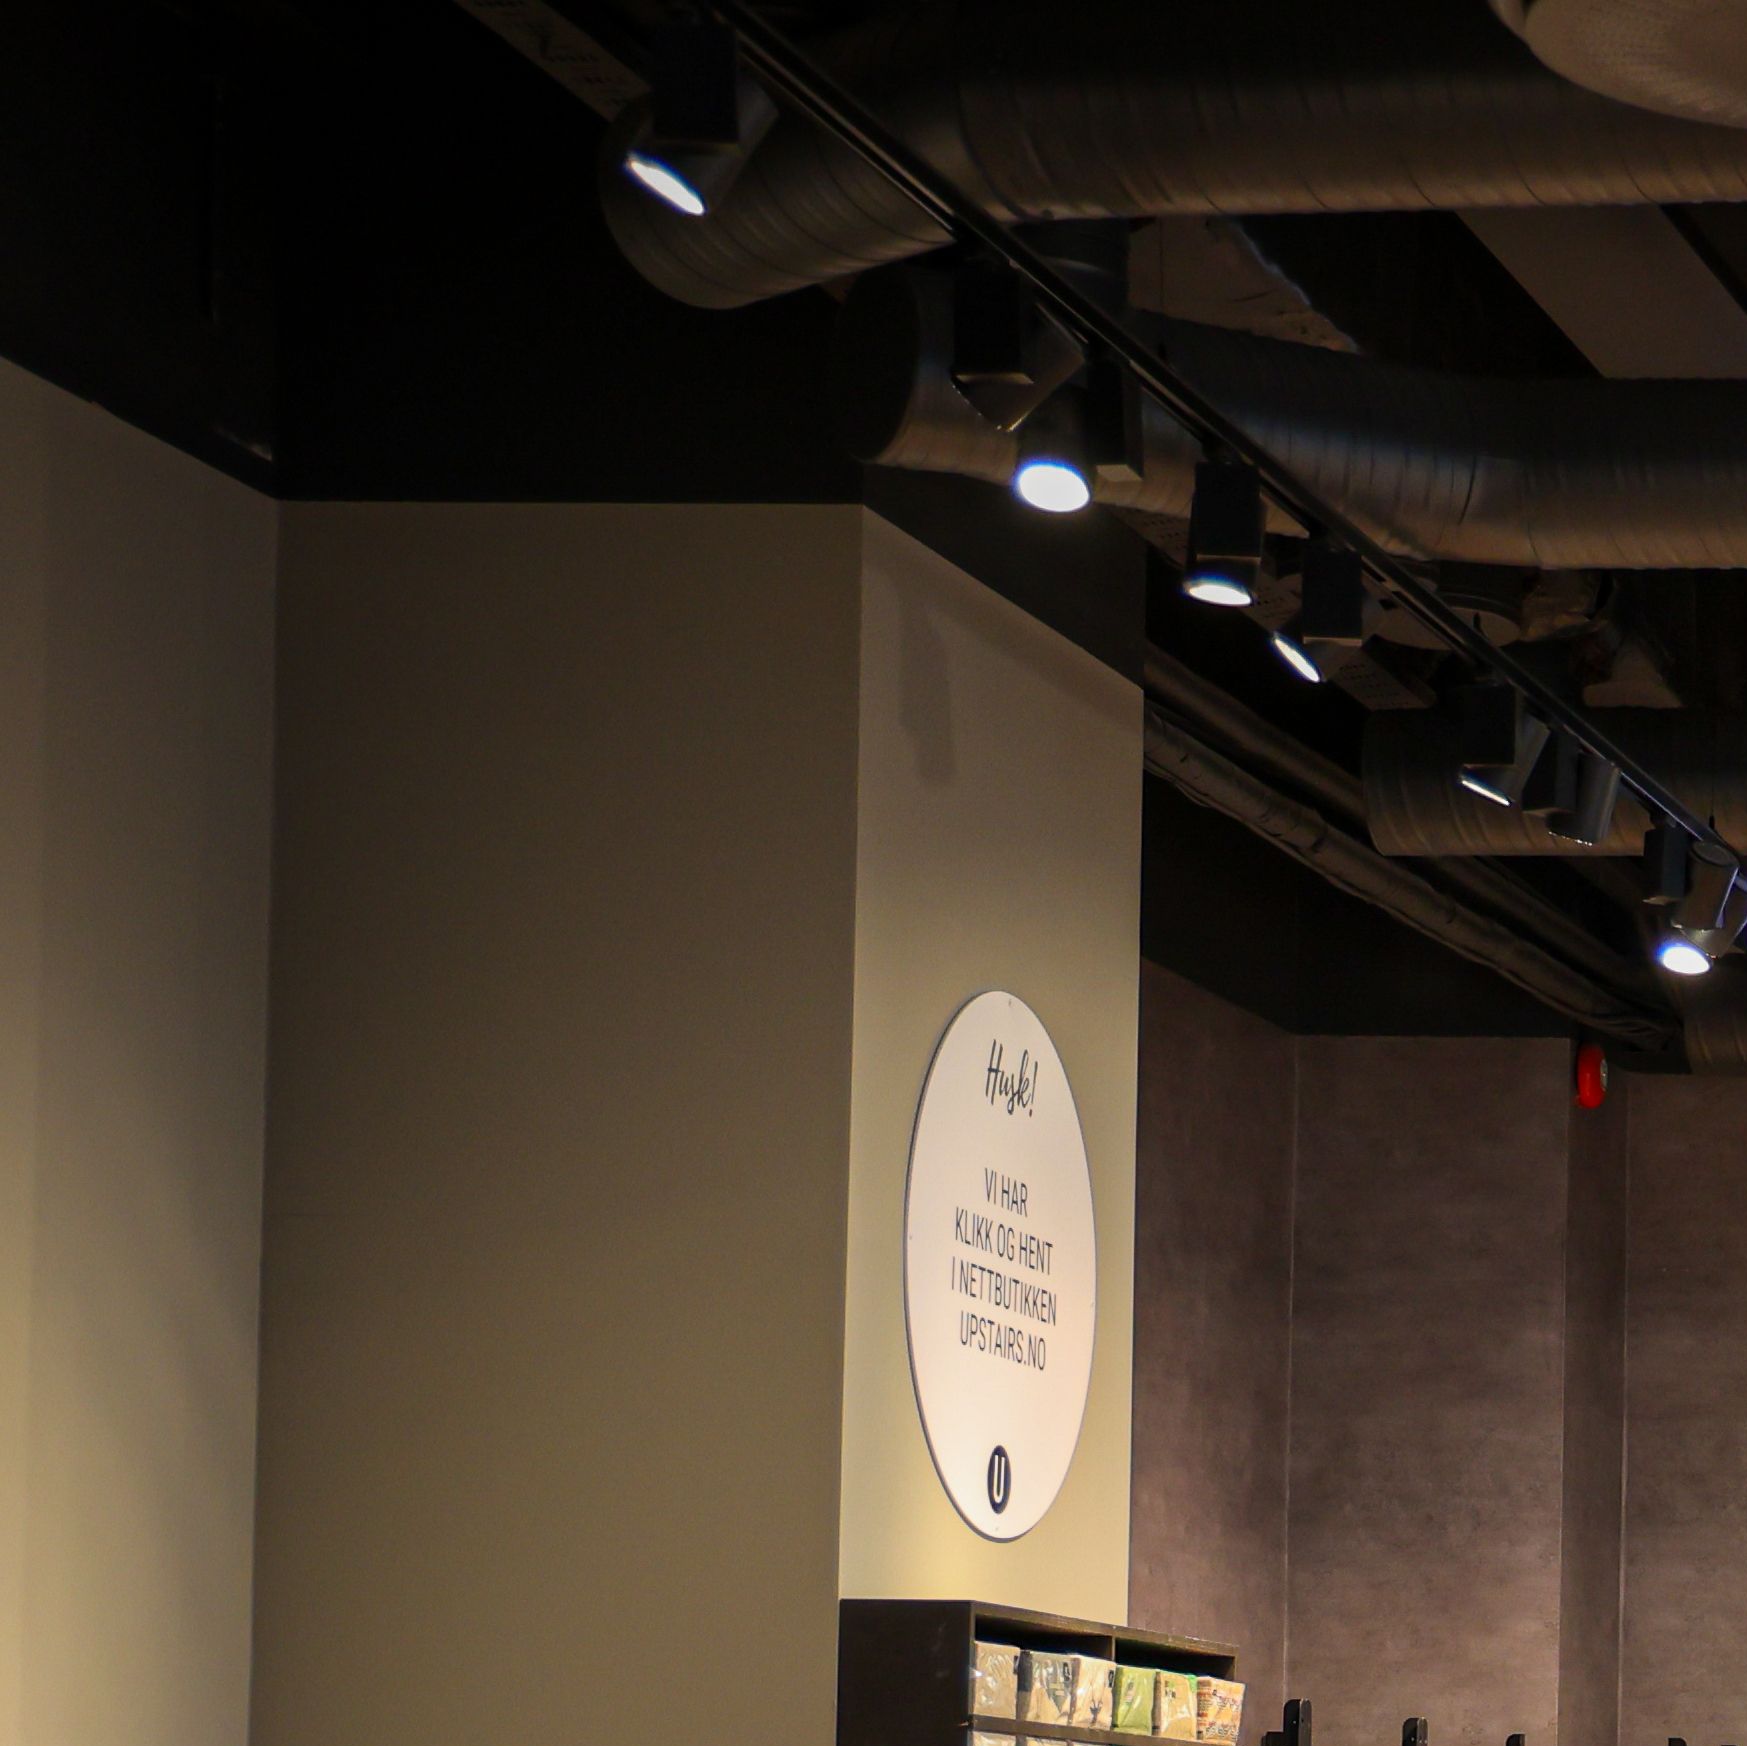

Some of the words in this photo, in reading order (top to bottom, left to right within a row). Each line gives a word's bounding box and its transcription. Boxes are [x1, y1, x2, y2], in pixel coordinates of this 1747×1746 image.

[985, 1039, 1038, 1117] Husk!
[984, 1167, 997, 1205] VI
[1001, 1174, 1028, 1218] HAR
[955, 1206, 993, 1254] KLIKK
[997, 1223, 1015, 1261] OG
[1019, 1231, 1053, 1275] HENT
[951, 1256, 955, 1290] I
[959, 1259, 1057, 1326] NETTBUTIKKEN
[960, 1310, 1046, 1371] UPSTAIRS.NO
